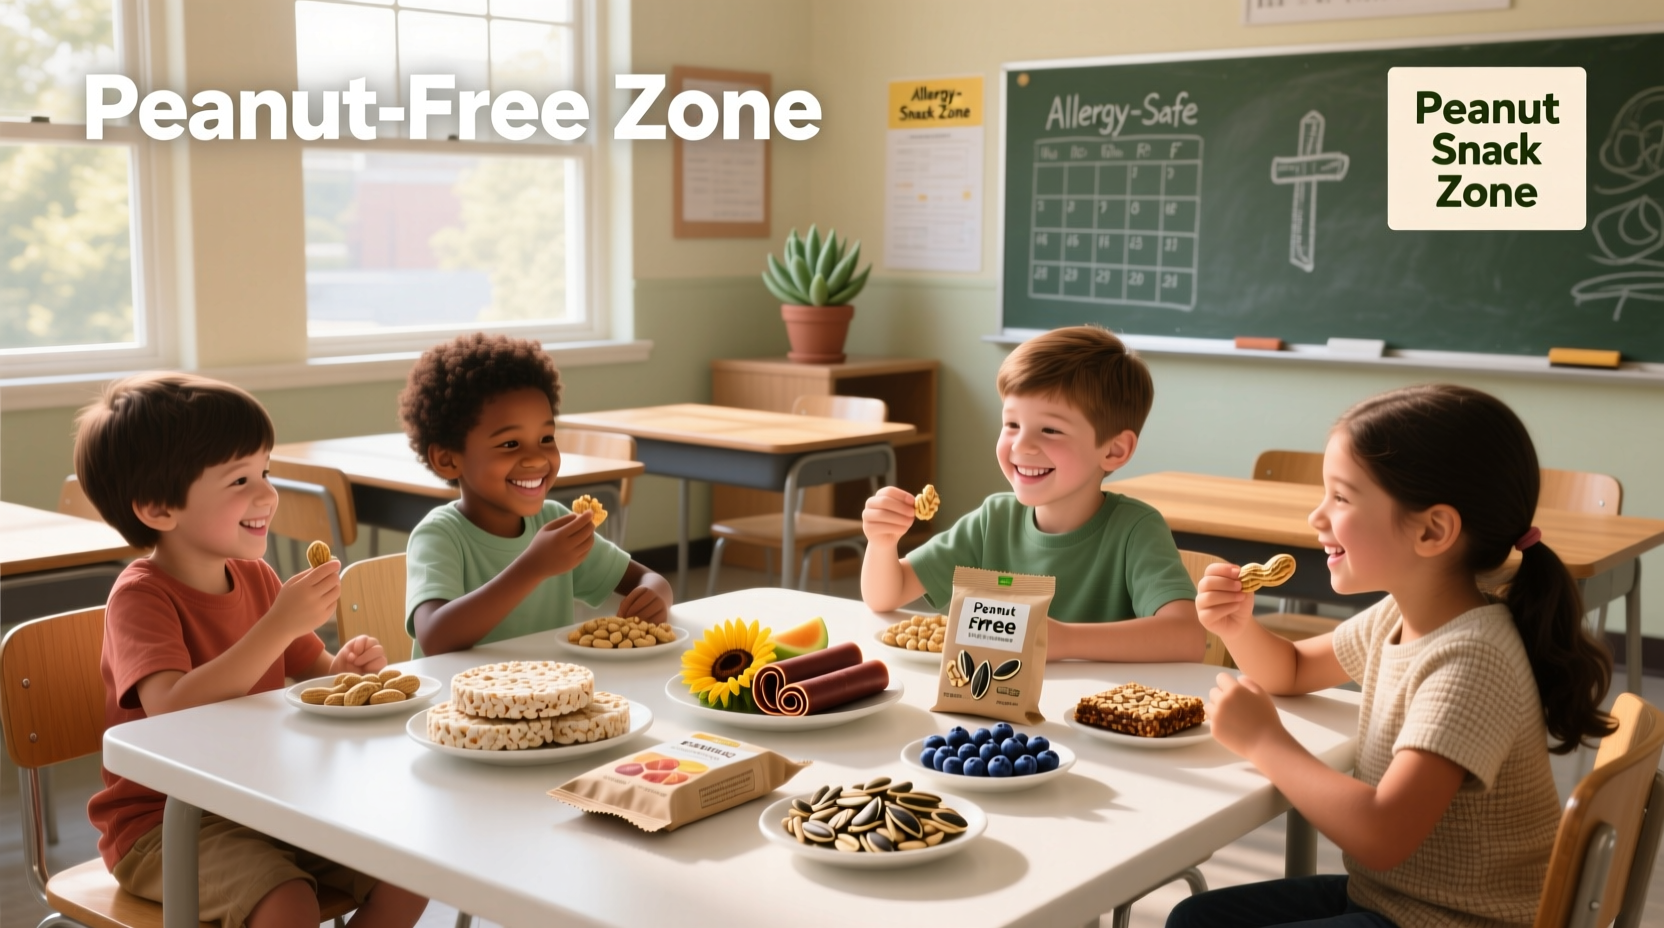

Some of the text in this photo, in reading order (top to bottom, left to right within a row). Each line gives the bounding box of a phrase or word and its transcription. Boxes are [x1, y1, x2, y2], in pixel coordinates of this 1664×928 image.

[911, 86, 962, 105] Allergy-
[939, 104, 971, 119] Zone
[1045, 91, 1198, 137] Allergy-Safe
